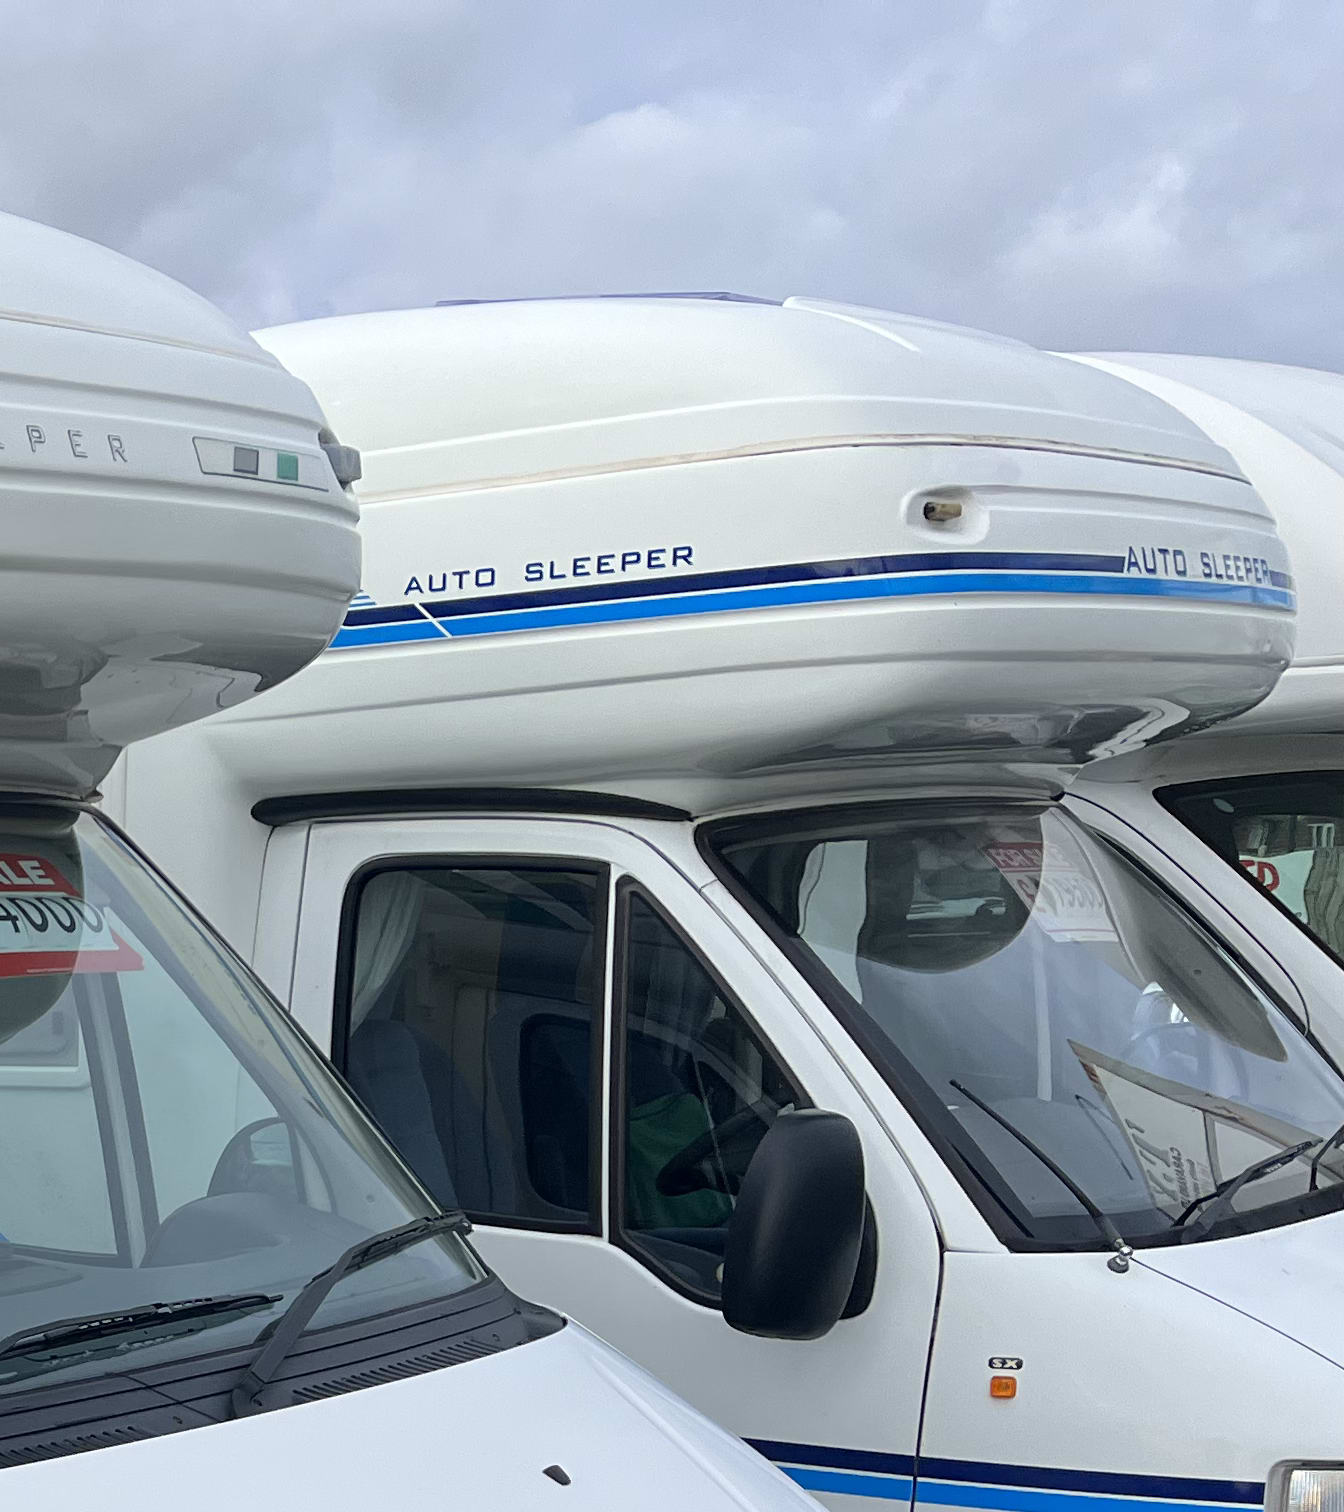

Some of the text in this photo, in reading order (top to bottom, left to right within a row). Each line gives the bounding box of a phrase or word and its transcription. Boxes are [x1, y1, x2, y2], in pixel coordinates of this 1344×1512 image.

[403, 545, 695, 597] AUTO SLEEPER
[1126, 546, 1270, 585] AUTO SLEEPER
[992, 1358, 1018, 1369] SX
